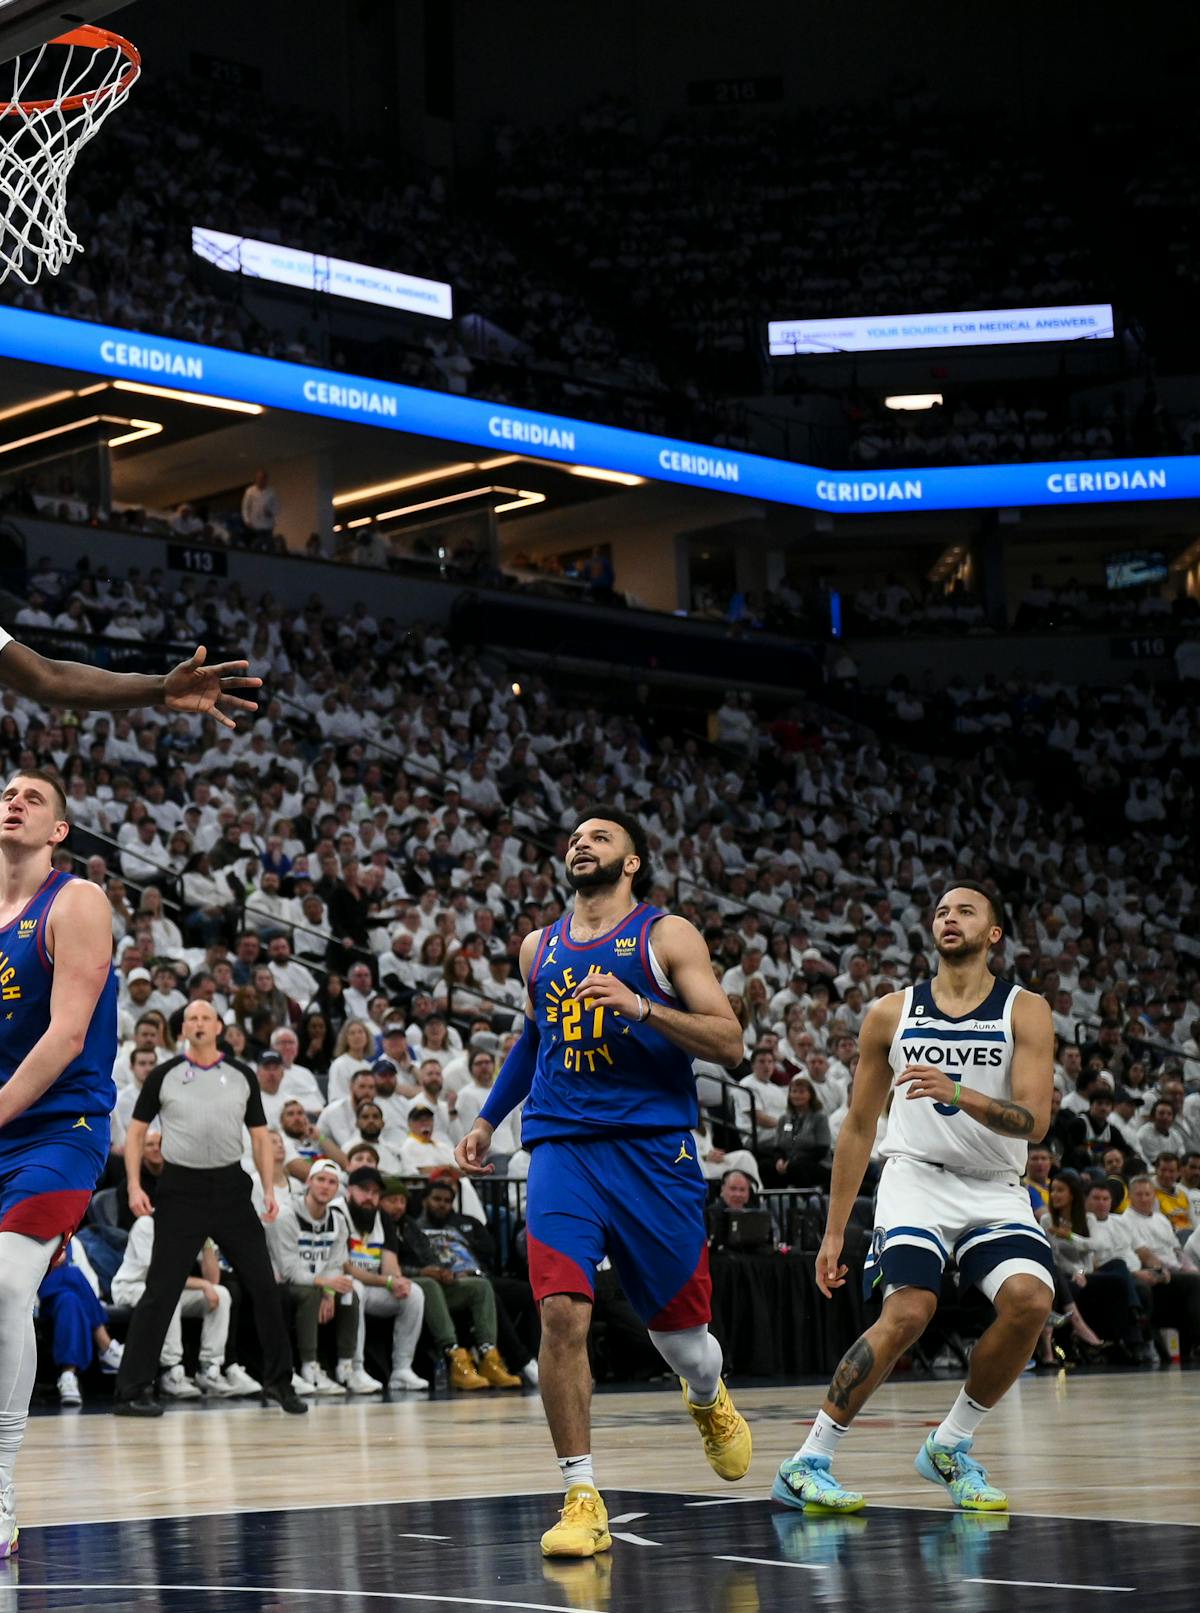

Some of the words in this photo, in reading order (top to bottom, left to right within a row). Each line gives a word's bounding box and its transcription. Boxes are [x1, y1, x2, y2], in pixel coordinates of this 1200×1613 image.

[902, 324, 949, 337] SOURCE
[953, 322, 976, 334] FOR
[980, 319, 1031, 333] MEDICAL
[100, 340, 203, 380] CERIDIAN
[303, 380, 397, 416] CERIDIAN
[488, 416, 575, 450] CERIDIAN
[659, 449, 739, 481] CERIDIAN
[816, 480, 922, 501] CERIDIAN
[1047, 470, 1166, 493] CERIDIAN
[183, 551, 213, 571] 113
[20, 919, 38, 930] WU
[615, 937, 636, 948] WU
[546, 967, 577, 1023] MILE
[561, 997, 605, 1041] 27
[914, 1005, 925, 1016] 6
[564, 1043, 614, 1072] CITY
[902, 1045, 1003, 1067] WOLVES
